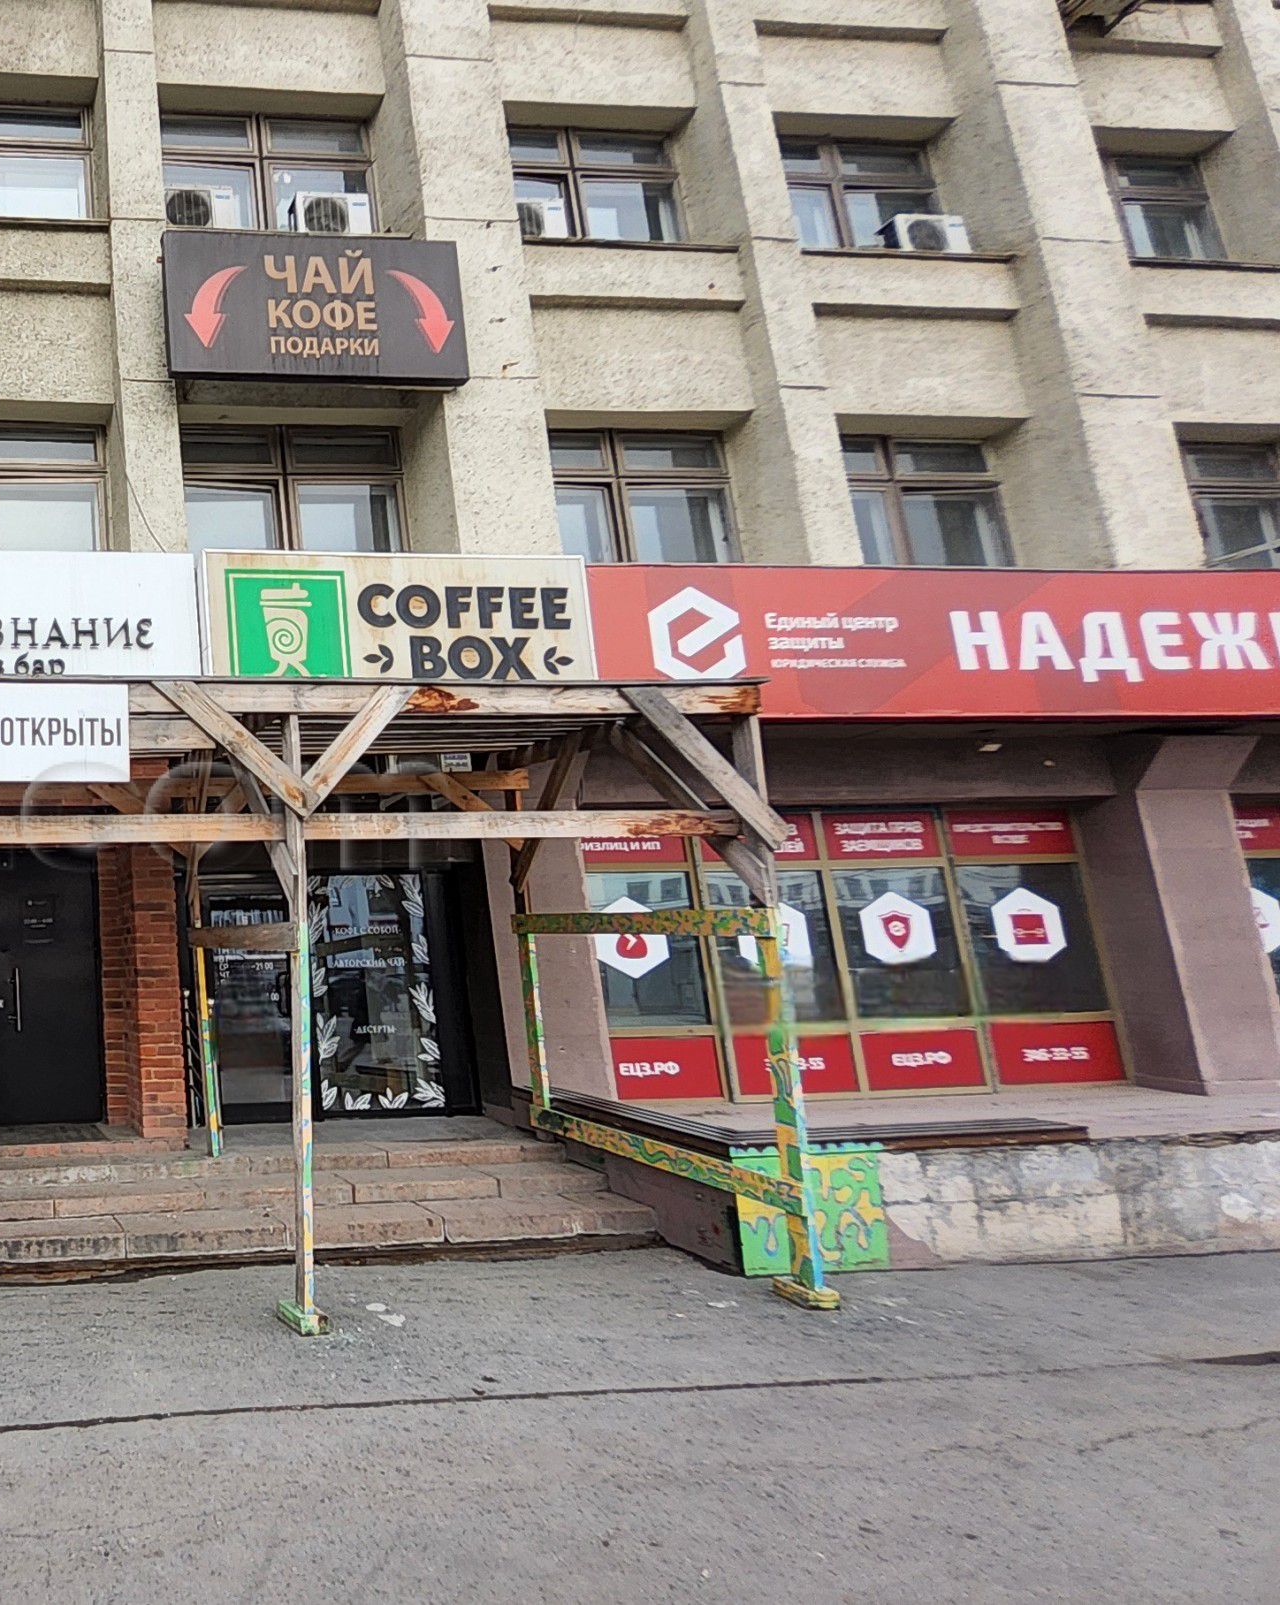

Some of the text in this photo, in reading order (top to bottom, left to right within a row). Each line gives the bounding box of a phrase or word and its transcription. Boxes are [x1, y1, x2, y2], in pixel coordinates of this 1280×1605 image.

[264, 249, 375, 294] ЧАЙ
[267, 299, 378, 331] КОФЕ
[270, 336, 380, 358] ПОДАРКИ
[357, 583, 572, 630] COFFEE
[764, 612, 899, 632] Единый центр
[409, 635, 536, 681] BOX
[767, 637, 845, 652] защиты
[949, 610, 1280, 683] НАДЕЖ
[14, 652, 65, 674] бар
[0, 716, 122, 747] ОТКРЫТЫ
